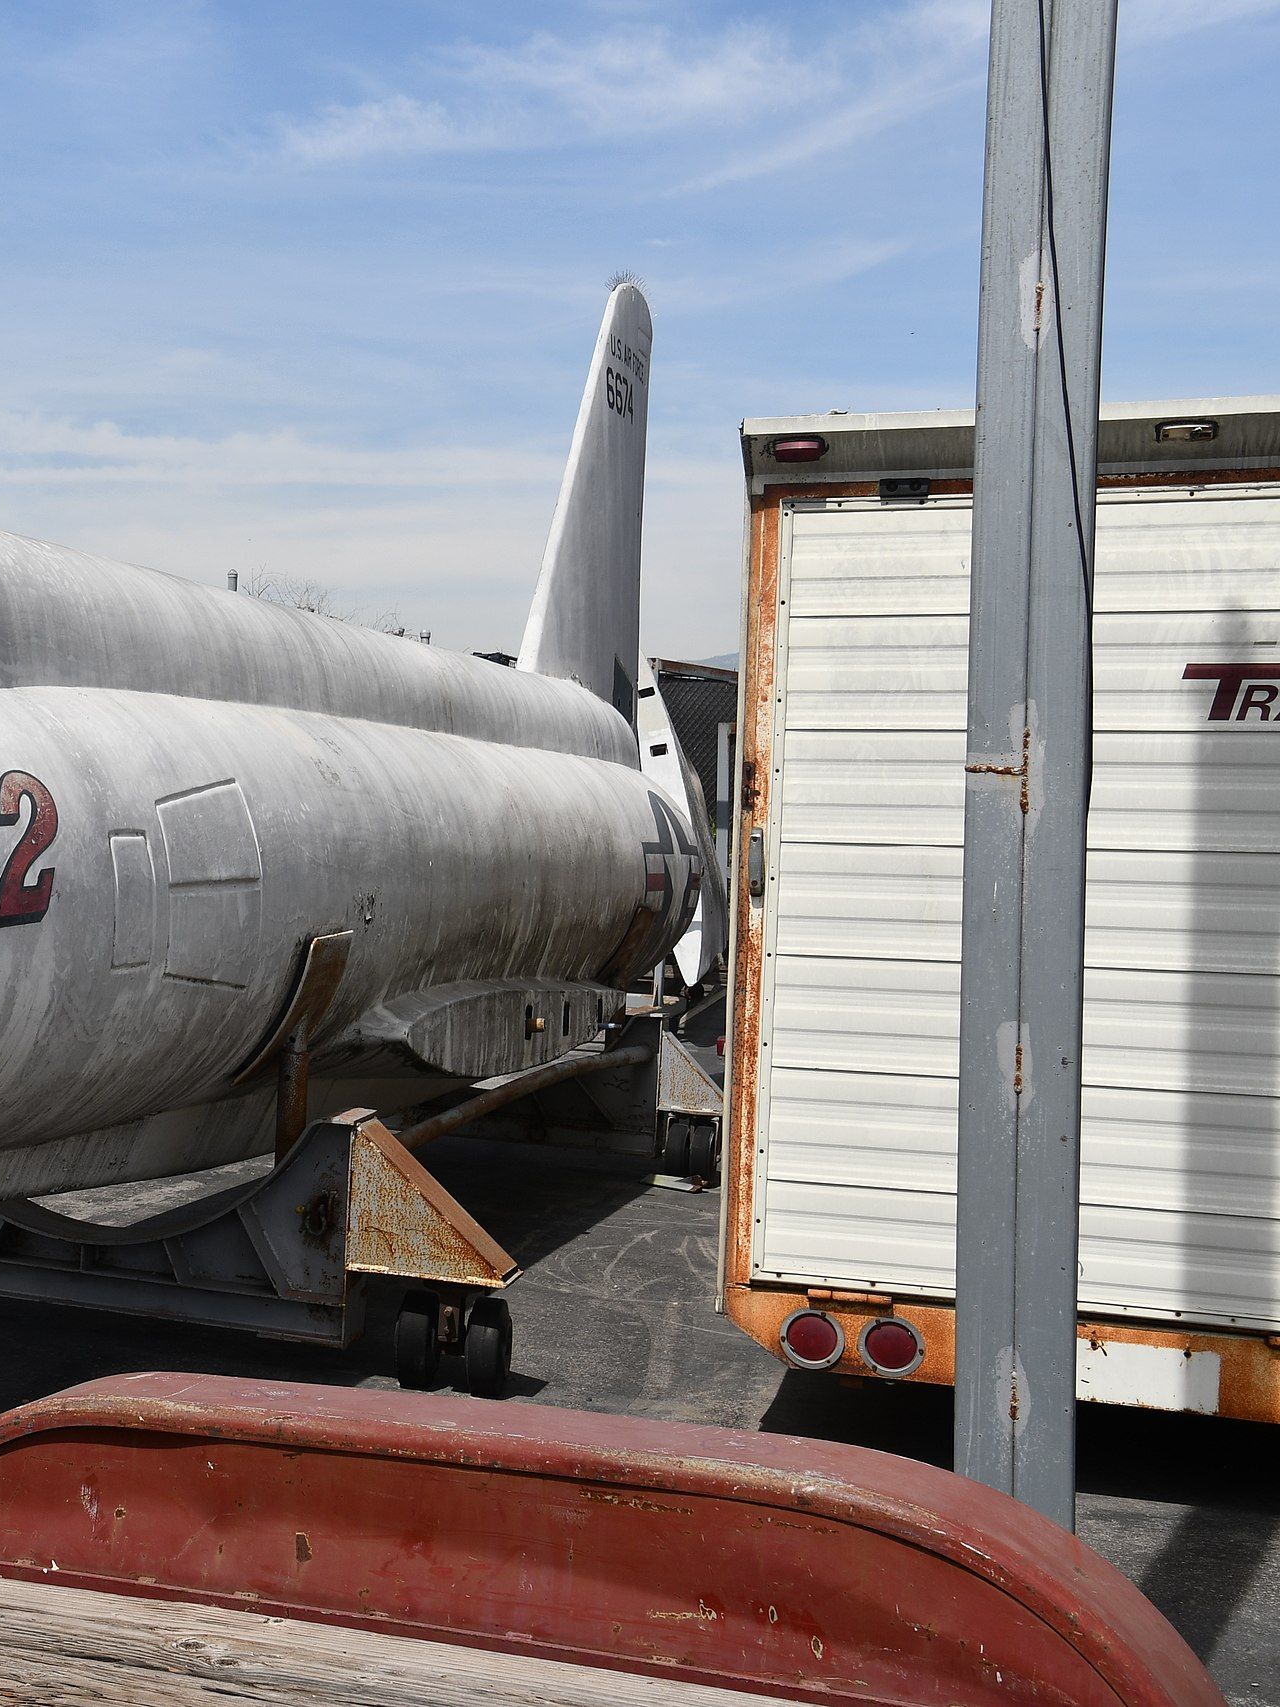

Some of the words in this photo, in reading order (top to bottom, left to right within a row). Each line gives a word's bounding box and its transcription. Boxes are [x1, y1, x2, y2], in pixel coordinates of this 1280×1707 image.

[624, 344, 632, 370] AIR
[606, 366, 634, 424] 6674
[1181, 663, 1280, 721] TR
